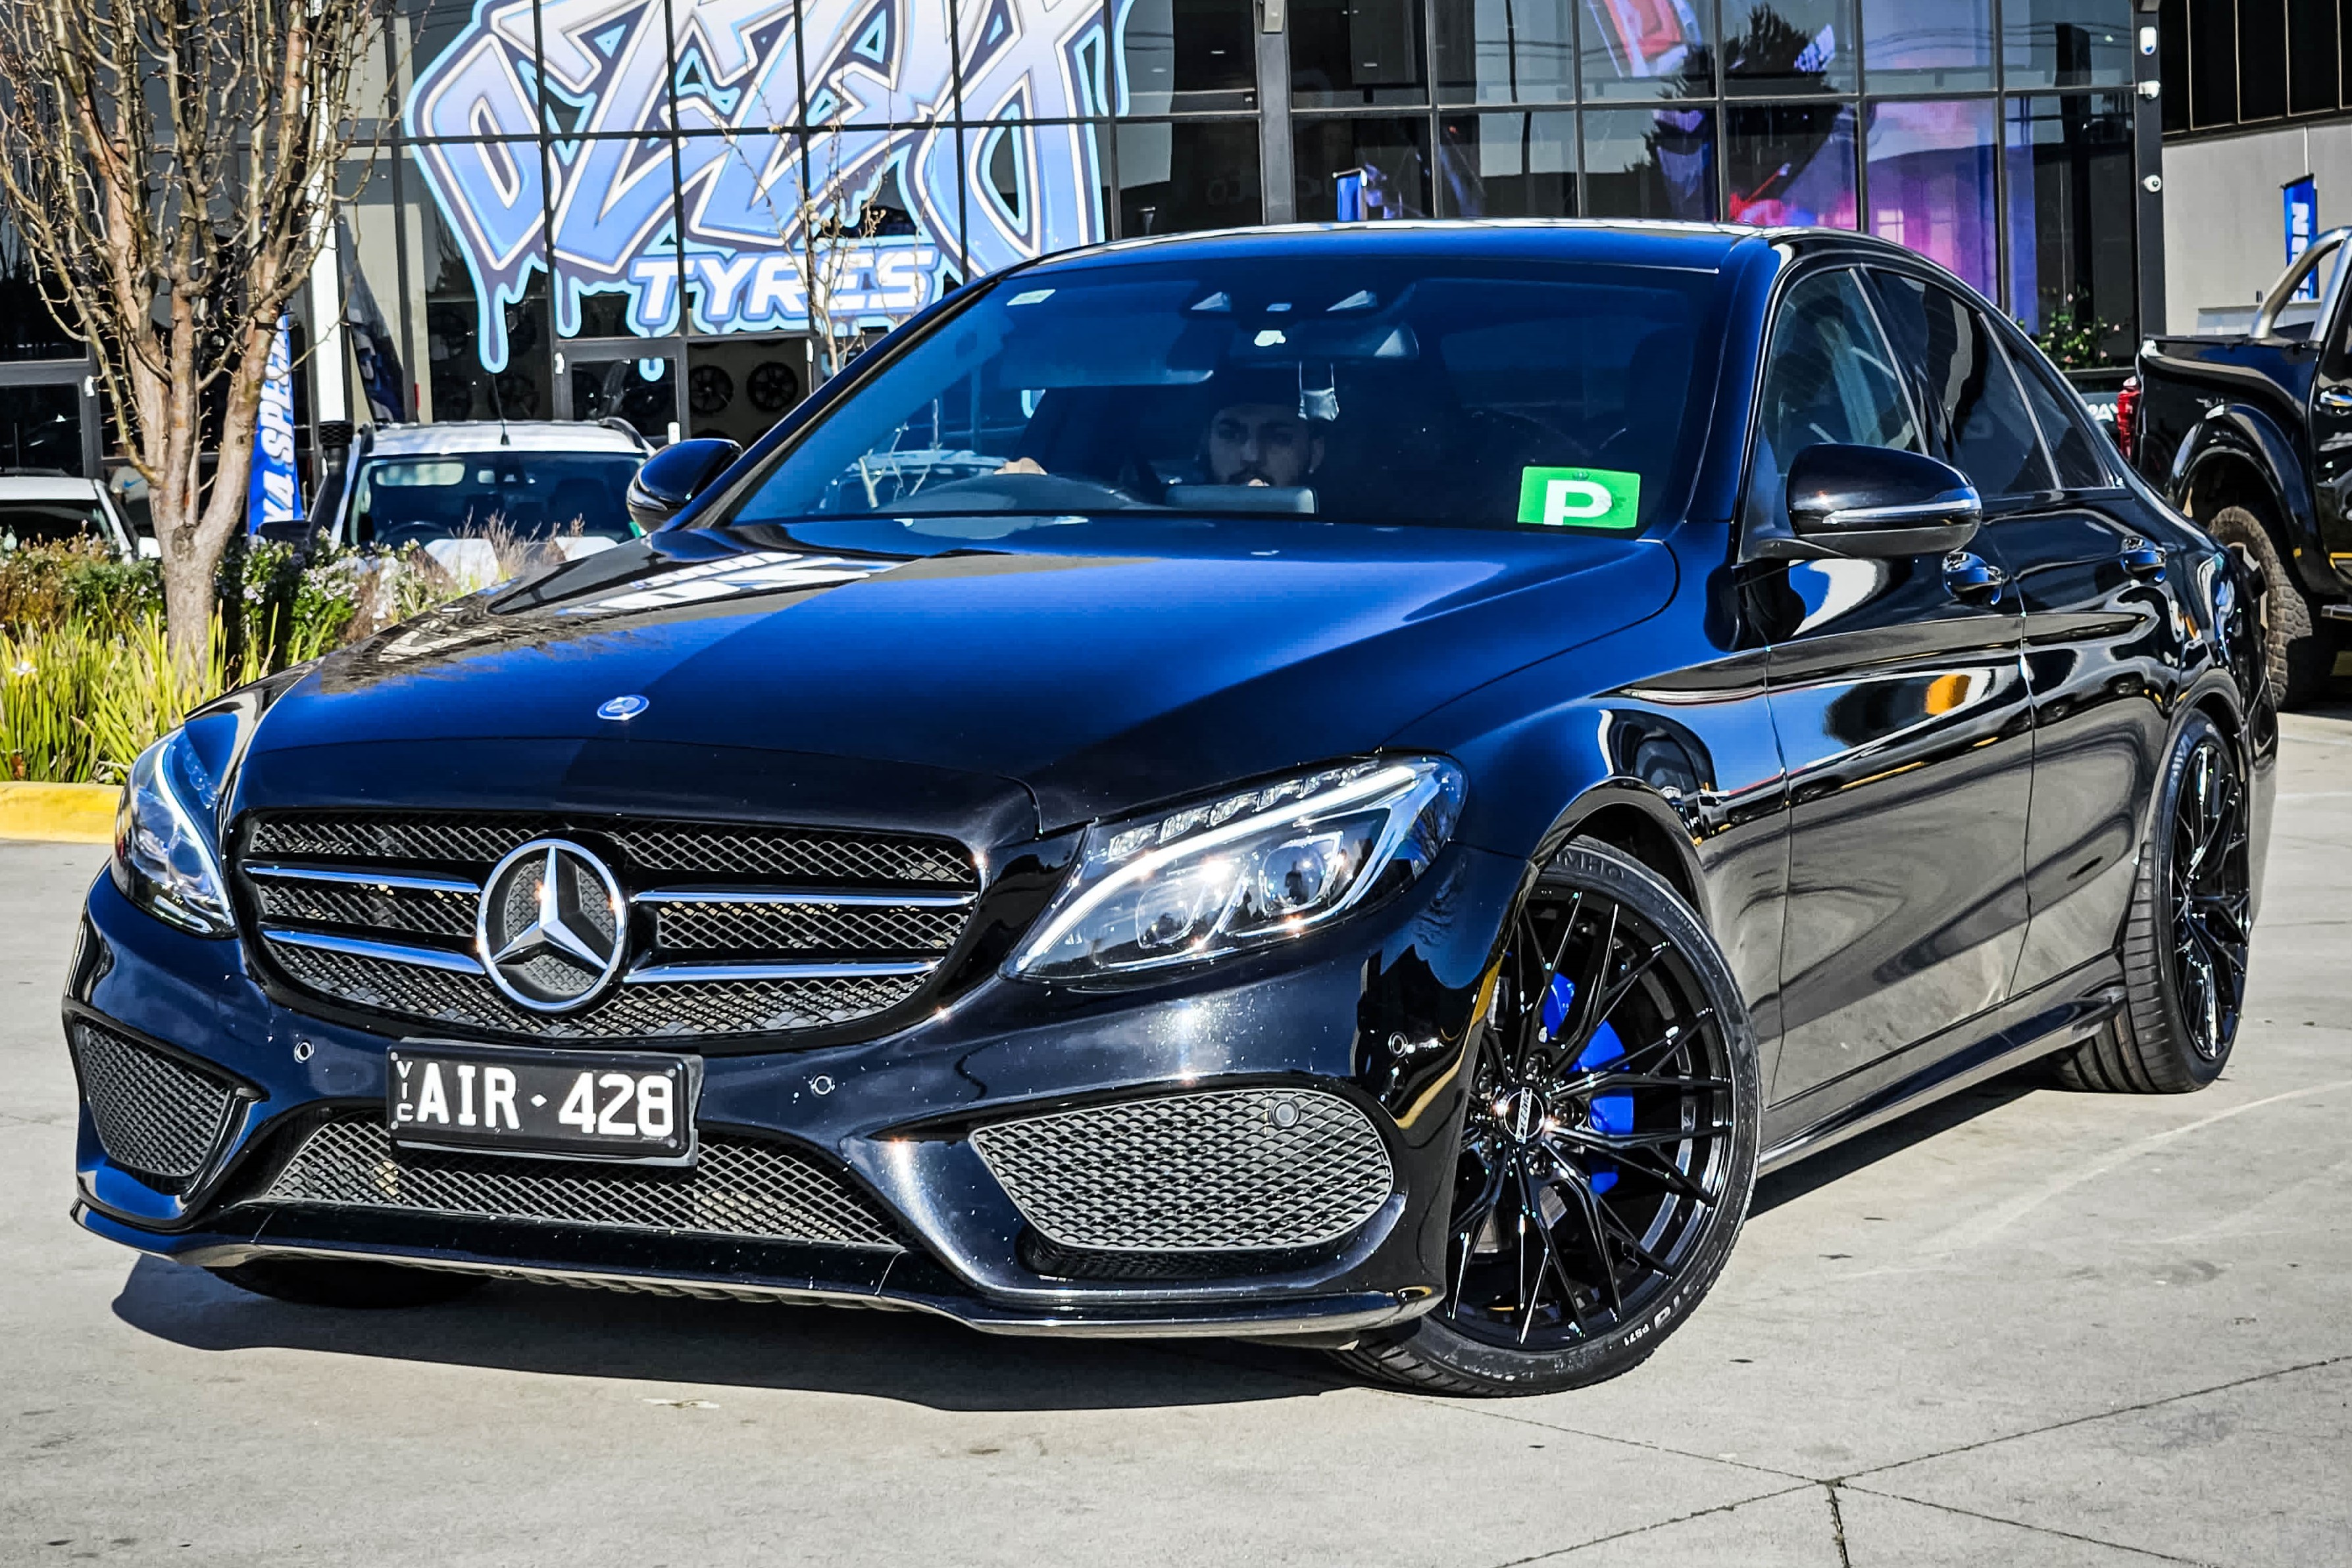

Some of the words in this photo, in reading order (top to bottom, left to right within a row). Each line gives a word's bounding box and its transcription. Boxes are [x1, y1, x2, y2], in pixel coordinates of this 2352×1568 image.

[631, 250, 935, 320] TYRES
[1543, 479, 1612, 526] P
[396, 1060, 413, 1122] VIC
[416, 1062, 520, 1130] AIR
[558, 1071, 674, 1137] 428
